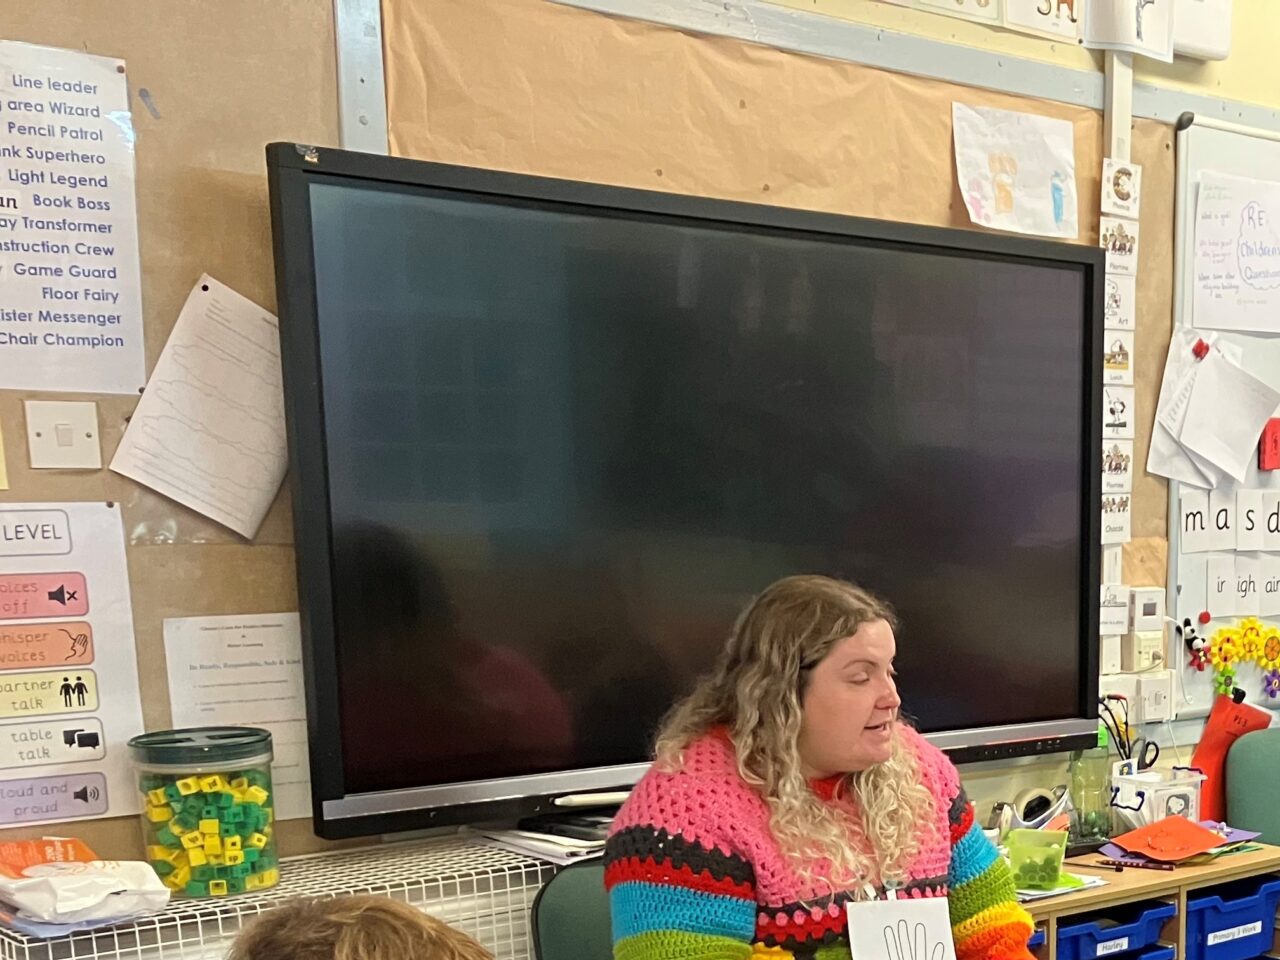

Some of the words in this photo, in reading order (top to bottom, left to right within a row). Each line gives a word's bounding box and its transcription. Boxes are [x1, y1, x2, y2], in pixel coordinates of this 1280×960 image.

[12, 74, 43, 89] Line
[48, 77, 98, 95] leader
[7, 101, 44, 113] area
[49, 101, 100, 118] Wizard
[7, 121, 55, 137] Pencil
[60, 126, 103, 141] Patrol
[26, 146, 106, 165] Superhero
[8, 168, 45, 185] Light
[50, 171, 108, 189] Legend
[32, 193, 73, 208] Book
[77, 196, 111, 211] Boss
[21, 216, 113, 234] Transformer
[75, 242, 115, 256] Crew
[13, 263, 64, 277] Game
[68, 264, 117, 279] Guard
[42, 287, 80, 301] Floor
[84, 288, 119, 305] Fairy
[38, 310, 122, 327] Messenger
[43, 333, 124, 349] Champion
[1184, 509, 1206, 533] m
[1215, 507, 1230, 530] a
[1245, 508, 1255, 531] s
[3, 524, 63, 541] LEVEL
[1217, 577, 1226, 593] ir
[1237, 574, 1256, 598] igh
[1265, 577, 1280, 593] air
[0, 630, 49, 648] hisper
[11, 698, 44, 711] talk
[11, 728, 53, 743] table
[18, 746, 51, 761] talk
[40, 783, 68, 796] and
[14, 800, 58, 817] proud
[1213, 930, 1235, 941] Primary
